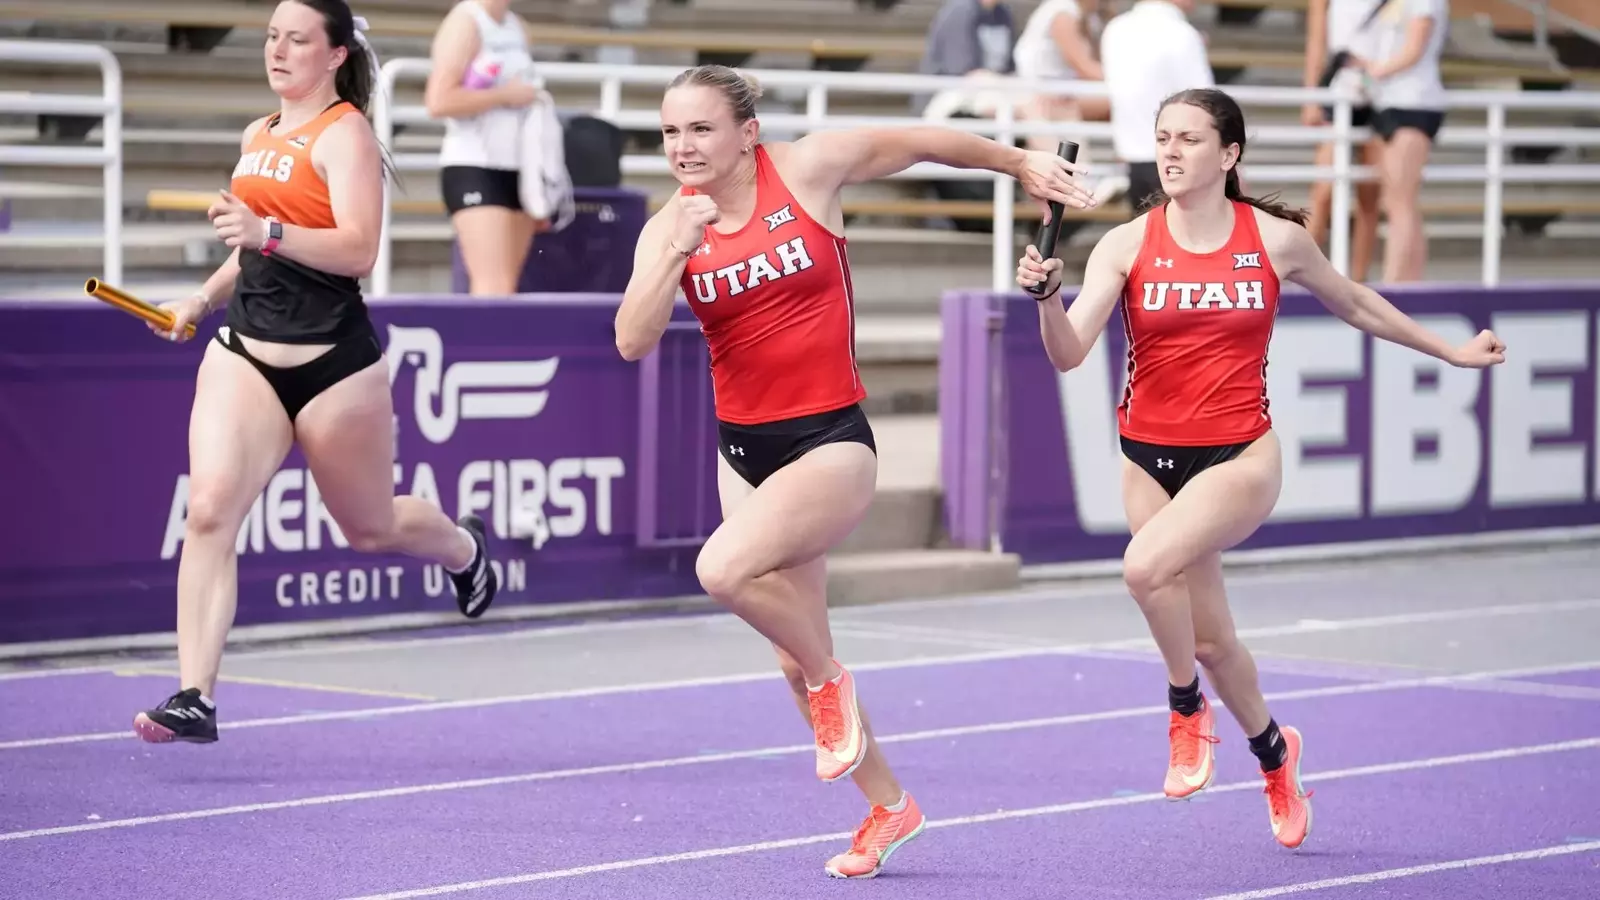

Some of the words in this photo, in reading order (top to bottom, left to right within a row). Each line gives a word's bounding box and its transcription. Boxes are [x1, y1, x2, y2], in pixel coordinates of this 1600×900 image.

[691, 236, 814, 304] UTAH
[1142, 281, 1265, 311] UTAH
[1056, 311, 1600, 534] EBE
[457, 456, 625, 540] FIRST
[276, 565, 404, 607] CREDIT
